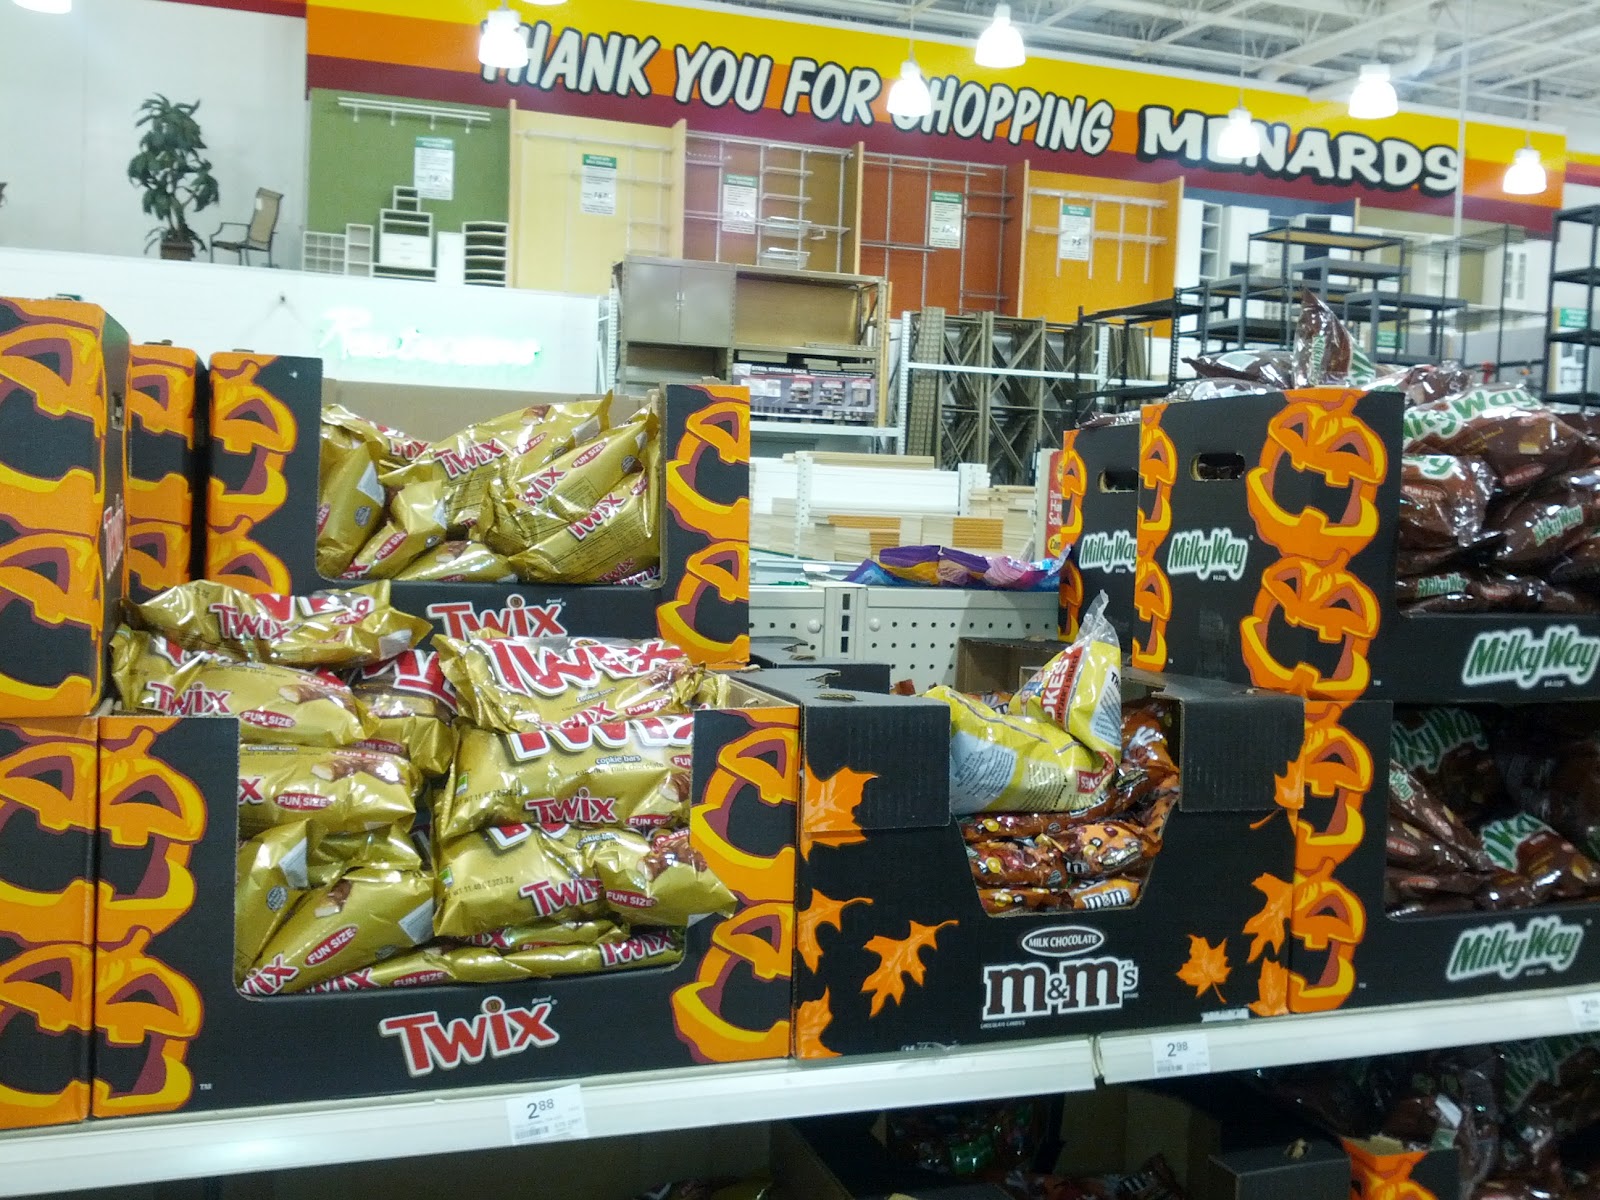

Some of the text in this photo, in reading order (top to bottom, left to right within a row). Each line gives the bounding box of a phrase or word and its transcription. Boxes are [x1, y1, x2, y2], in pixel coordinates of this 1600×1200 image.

[480, 21, 1114, 157] HANK YOU FOR HOPPING
[1138, 104, 1462, 195] MNARDS
[572, 441, 606, 468] FUN SIZE
[375, 542, 392, 560] FUN
[243, 710, 294, 728] FUN SIZE
[596, 754, 642, 766] cookie bars
[277, 795, 328, 808] FUN SIZE
[628, 816, 651, 826] FUN
[606, 891, 653, 907] FUN SIZE
[306, 927, 356, 965] FUN SIZE
[1028, 933, 1098, 948] MILK CHOCOLATE
[419, 972, 444, 983] SIZE
